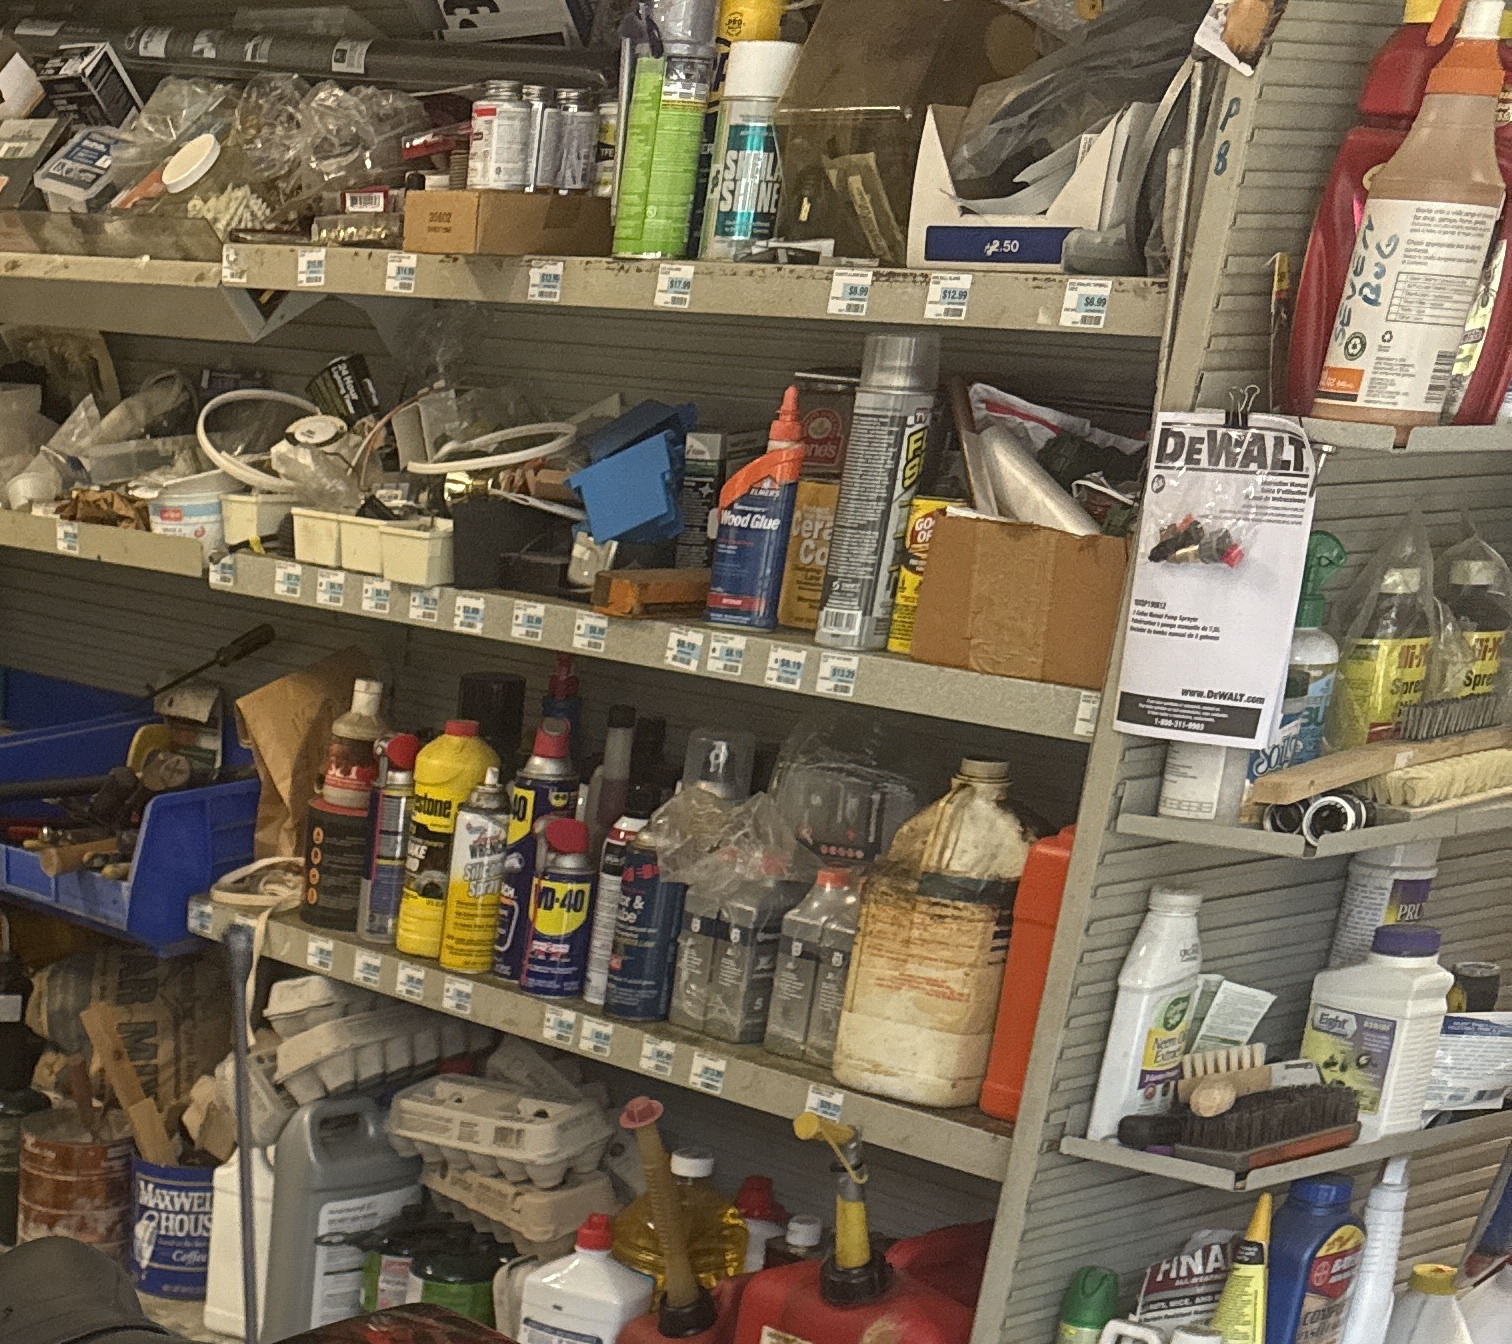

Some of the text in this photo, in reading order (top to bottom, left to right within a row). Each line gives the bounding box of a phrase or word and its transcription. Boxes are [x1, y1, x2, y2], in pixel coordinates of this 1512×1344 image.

[719, 181, 781, 213] SHINE
[1358, 234, 1400, 307] BUG
[1154, 428, 1307, 472] DEWALT
[720, 509, 782, 531] Wood Glue
[799, 539, 830, 566] Co
[1390, 678, 1421, 696] Spre
[1463, 669, 1492, 691] Spre
[157, 1212, 214, 1238] HOUS
[1156, 1244, 1227, 1282] FINA
